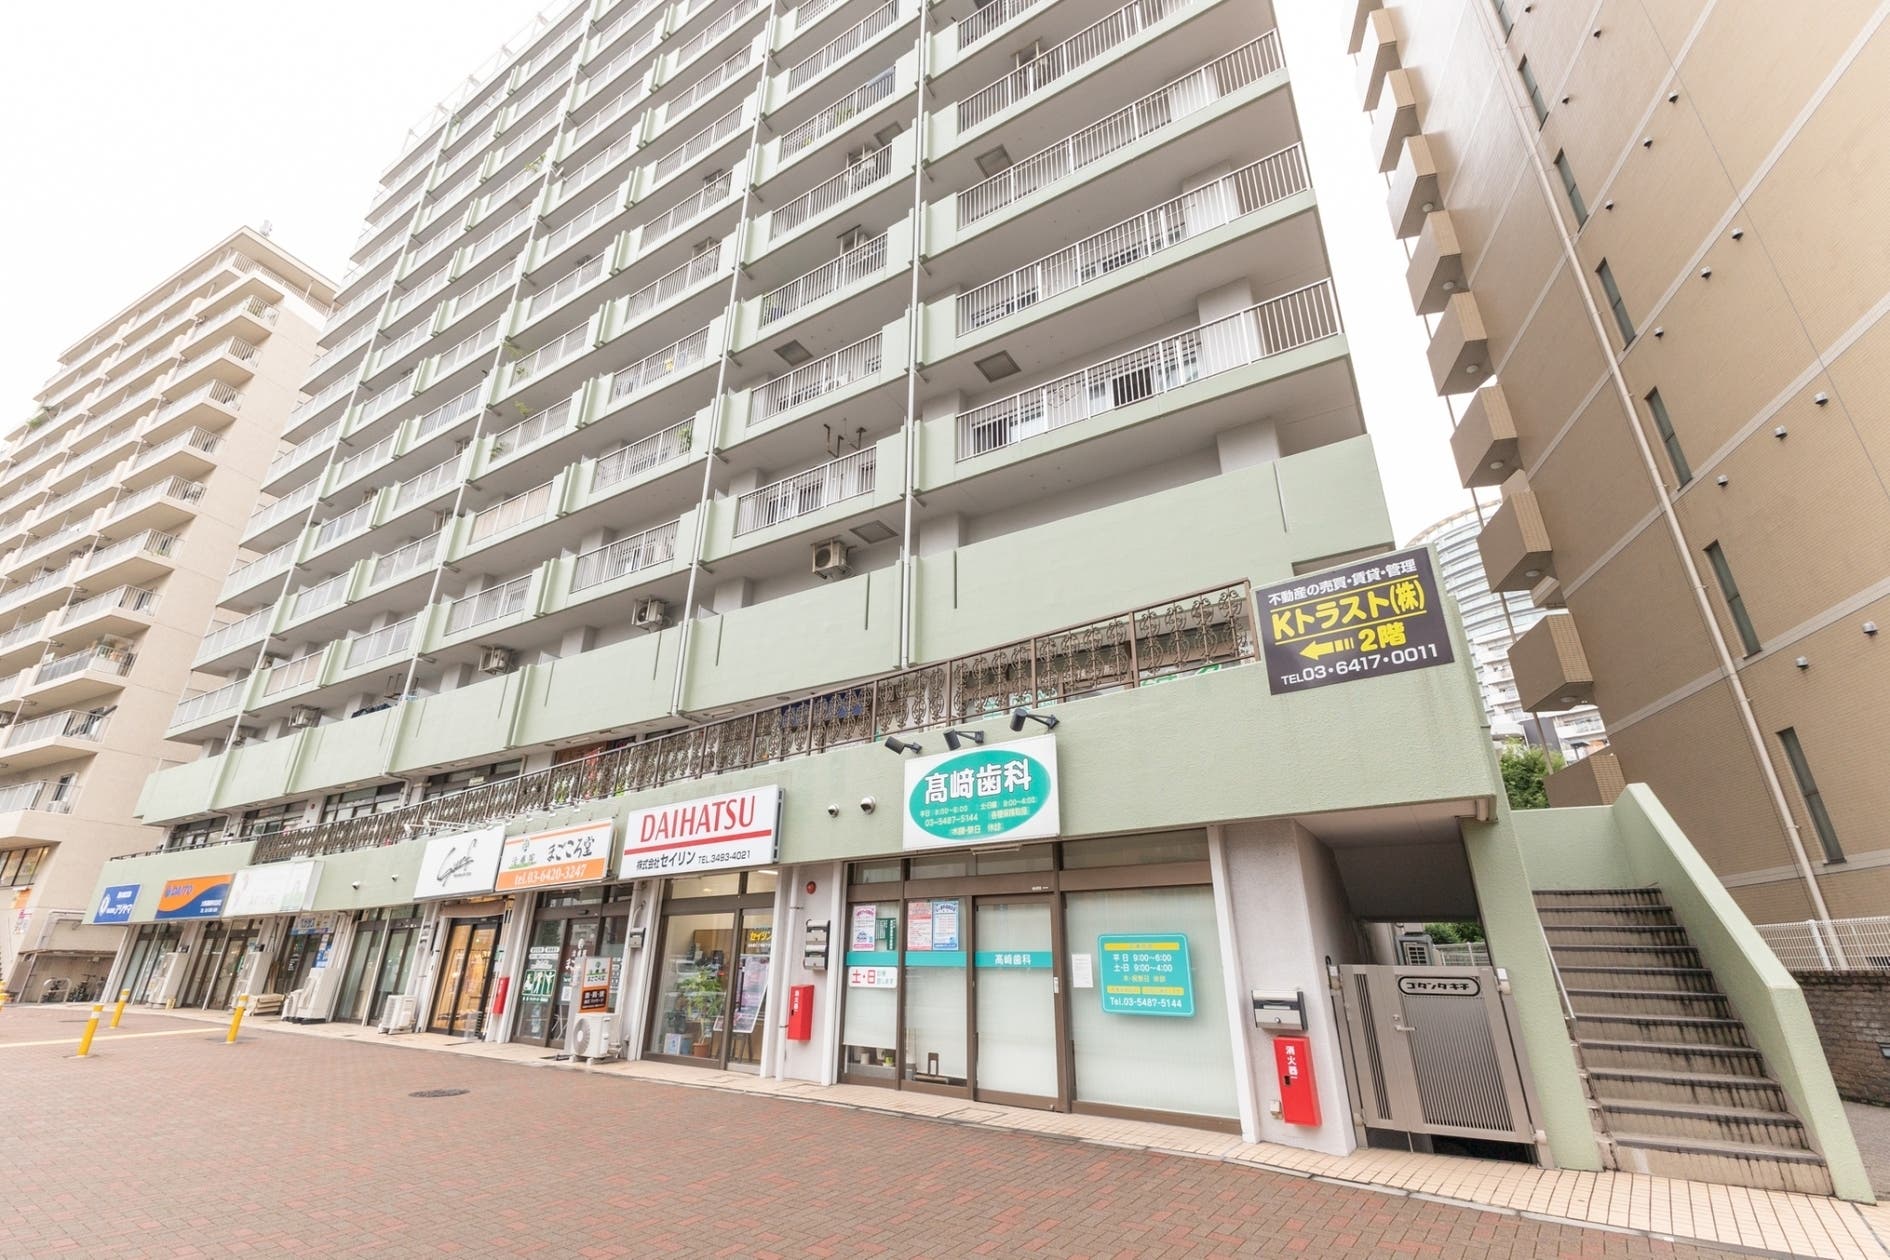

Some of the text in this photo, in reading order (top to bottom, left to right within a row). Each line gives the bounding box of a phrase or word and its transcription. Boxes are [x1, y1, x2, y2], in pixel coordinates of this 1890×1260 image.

[1268, 559, 1417, 606] 不動産の売買・賃貸・管理
[1358, 622, 1406, 652] 2階
[640, 795, 756, 843] DAIHATSU
[547, 835, 595, 862] まごころ堂
